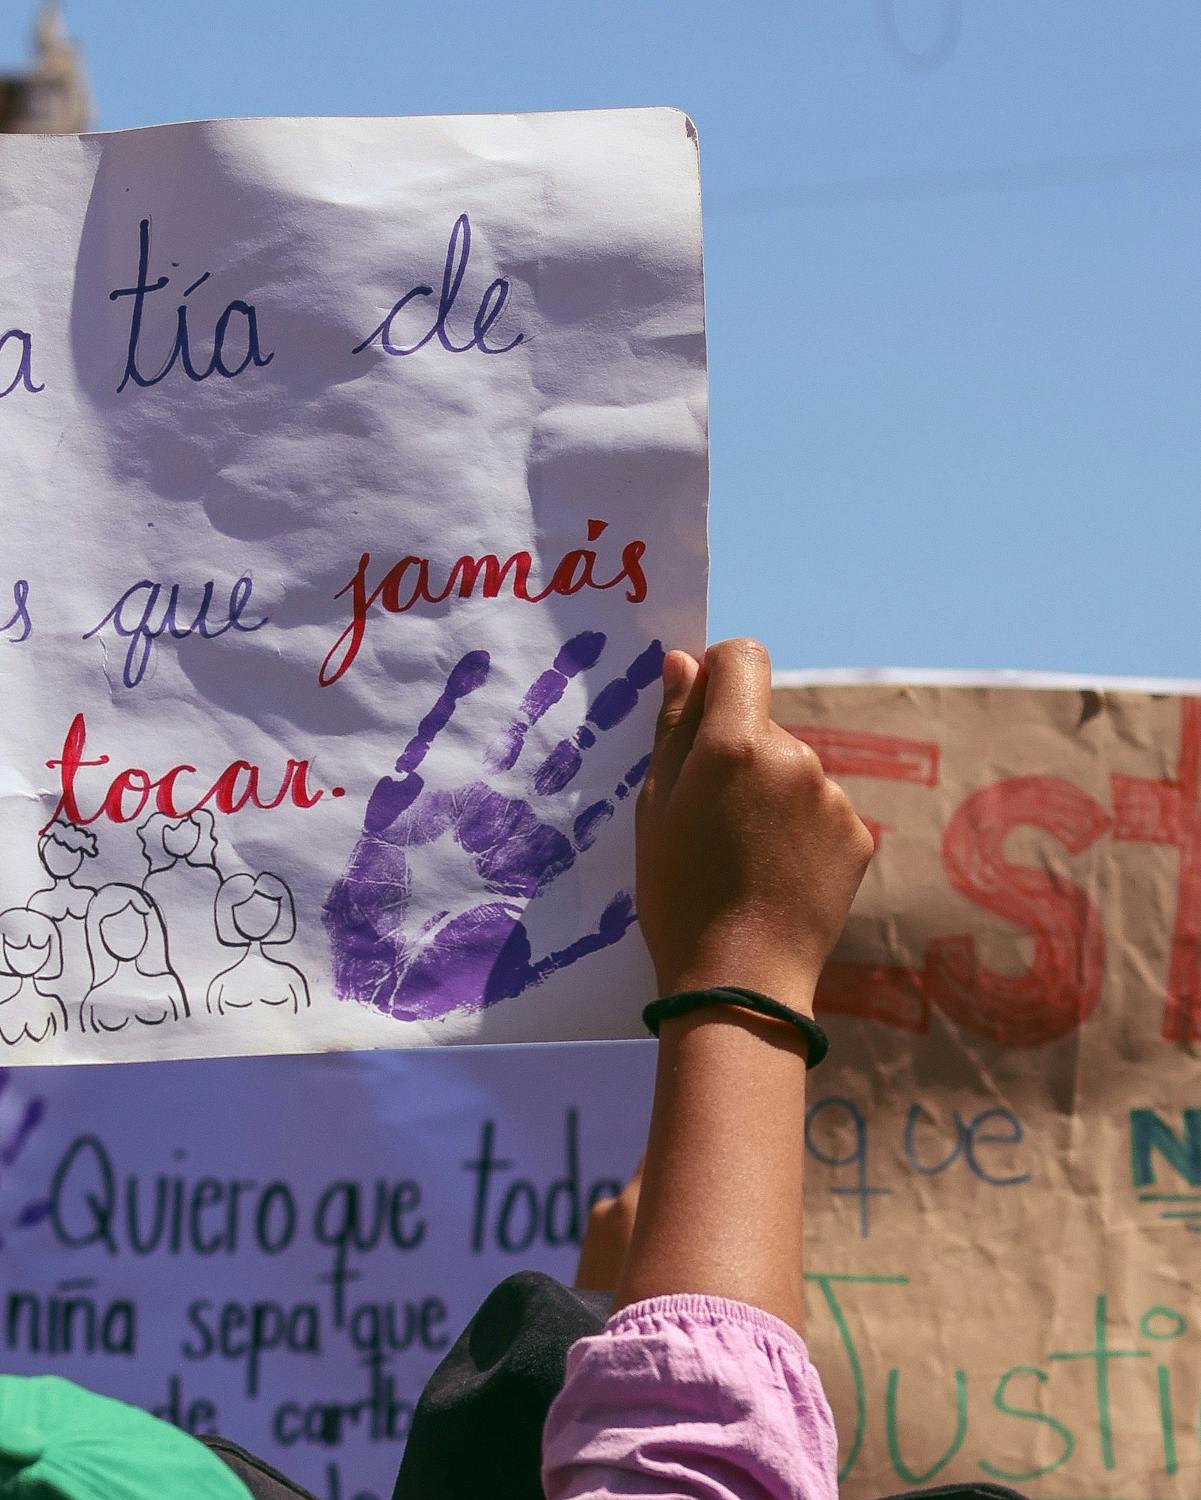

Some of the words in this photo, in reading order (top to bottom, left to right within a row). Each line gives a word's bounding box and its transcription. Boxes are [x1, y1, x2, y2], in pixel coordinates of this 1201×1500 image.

[110, 218, 275, 394] tía
[352, 213, 526, 356] de
[83, 576, 270, 688] que
[319, 519, 647, 687] jamás
[41, 713, 347, 836] tocar.
[48, 1133, 297, 1257] Quiero
[313, 1175, 427, 1335] que
[804, 1096, 1033, 1240] que
[5, 1276, 137, 1358] niña
[181, 1292, 319, 1397] sepa
[349, 1294, 450, 1437] que
[803, 1274, 1201, 1484] Justi
